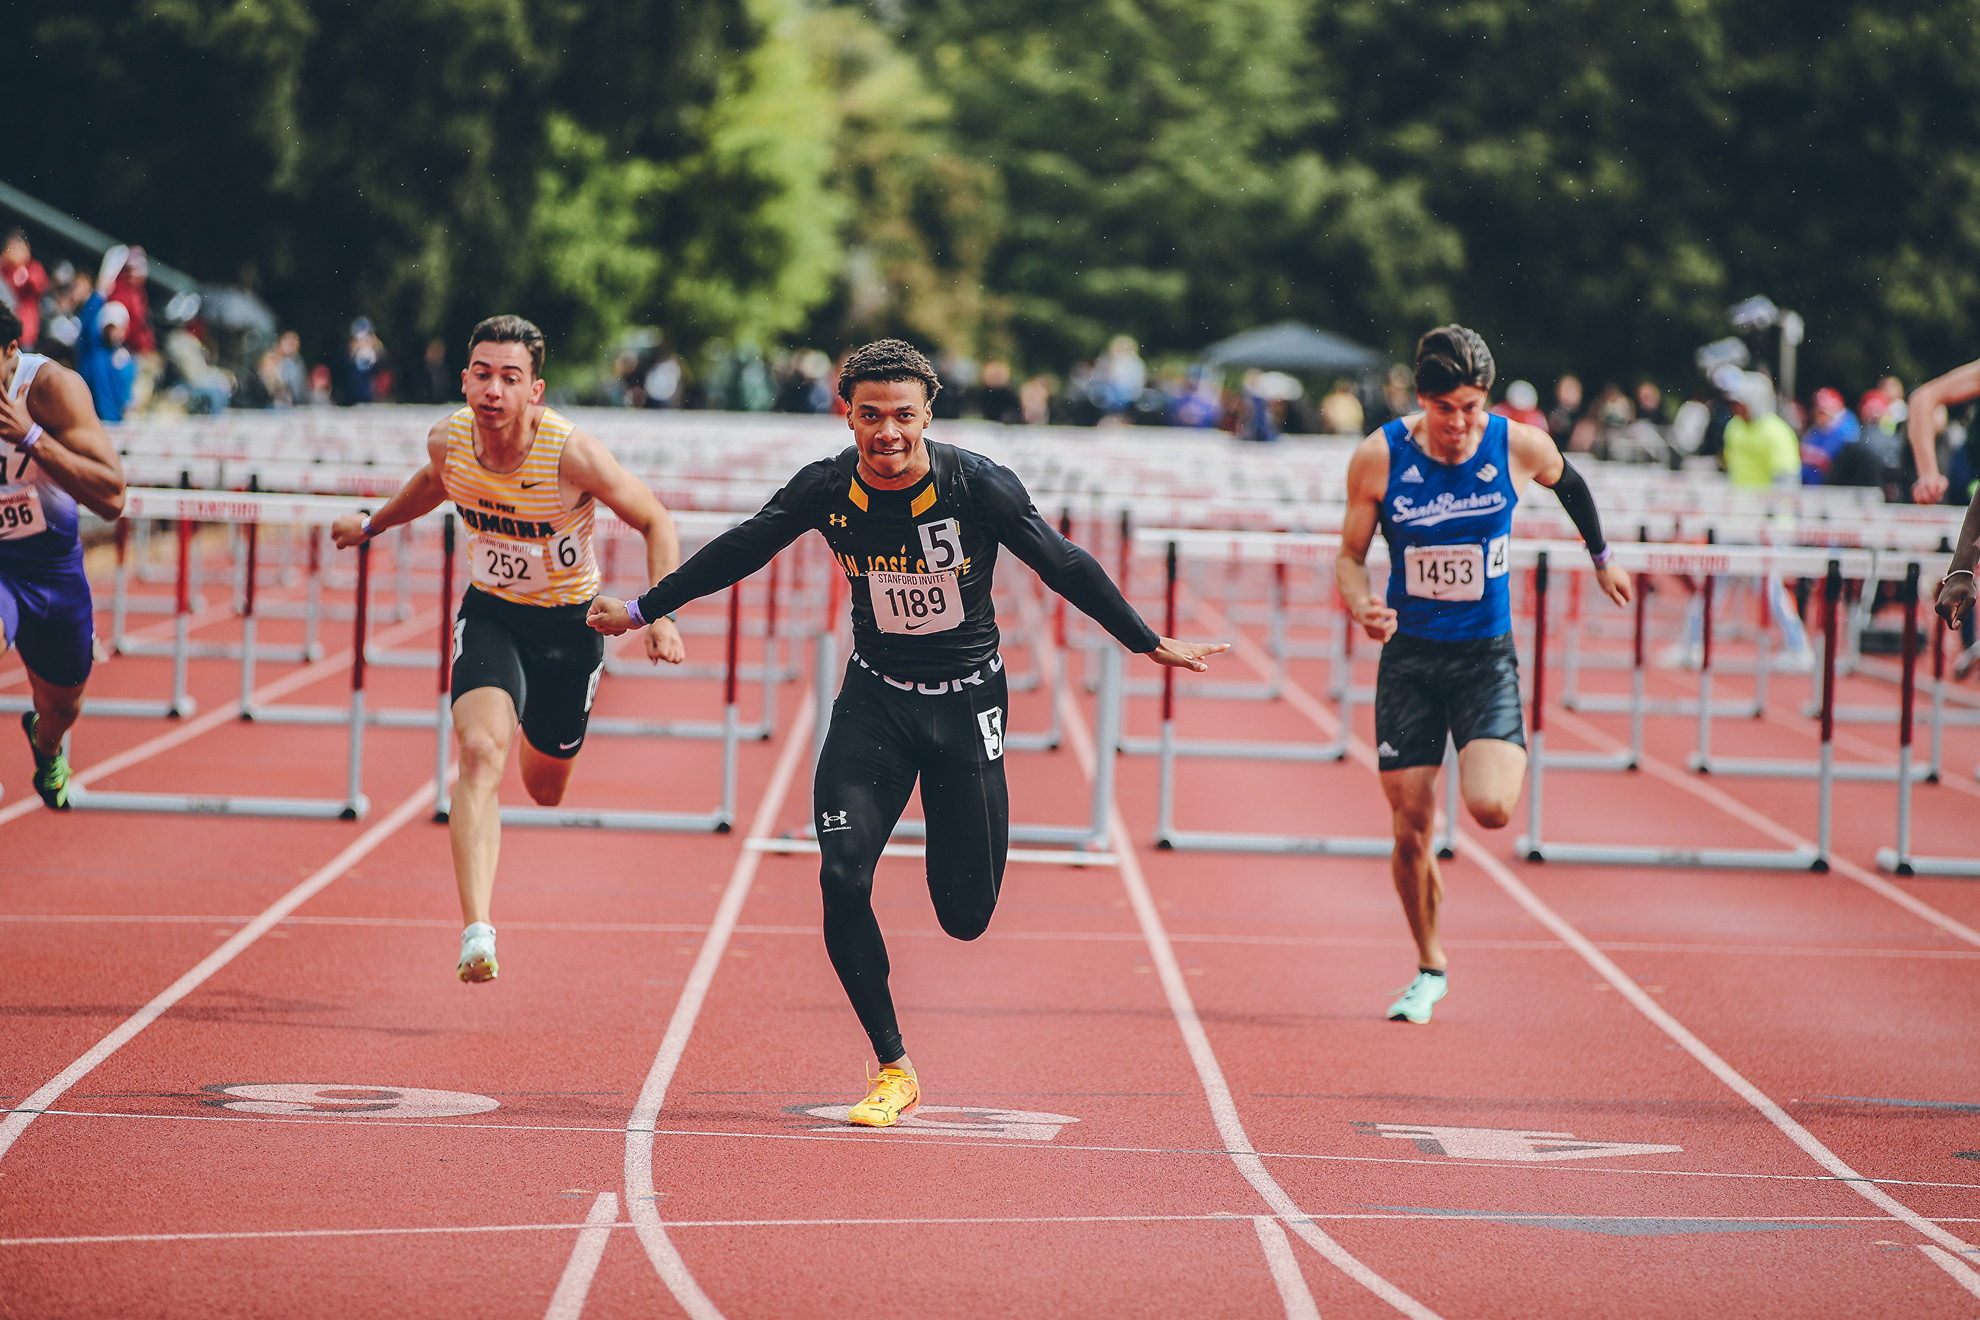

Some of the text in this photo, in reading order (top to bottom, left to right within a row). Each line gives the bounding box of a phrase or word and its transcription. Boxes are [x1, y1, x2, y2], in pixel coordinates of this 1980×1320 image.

[558, 536, 576, 567] 6
[928, 523, 955, 568] 5
[486, 550, 531, 580] 252
[837, 552, 860, 577] AN
[878, 573, 946, 585] STANFORD INVITE
[1416, 559, 1473, 585] 1453
[885, 587, 947, 618] 1189
[986, 711, 1000, 755] 5
